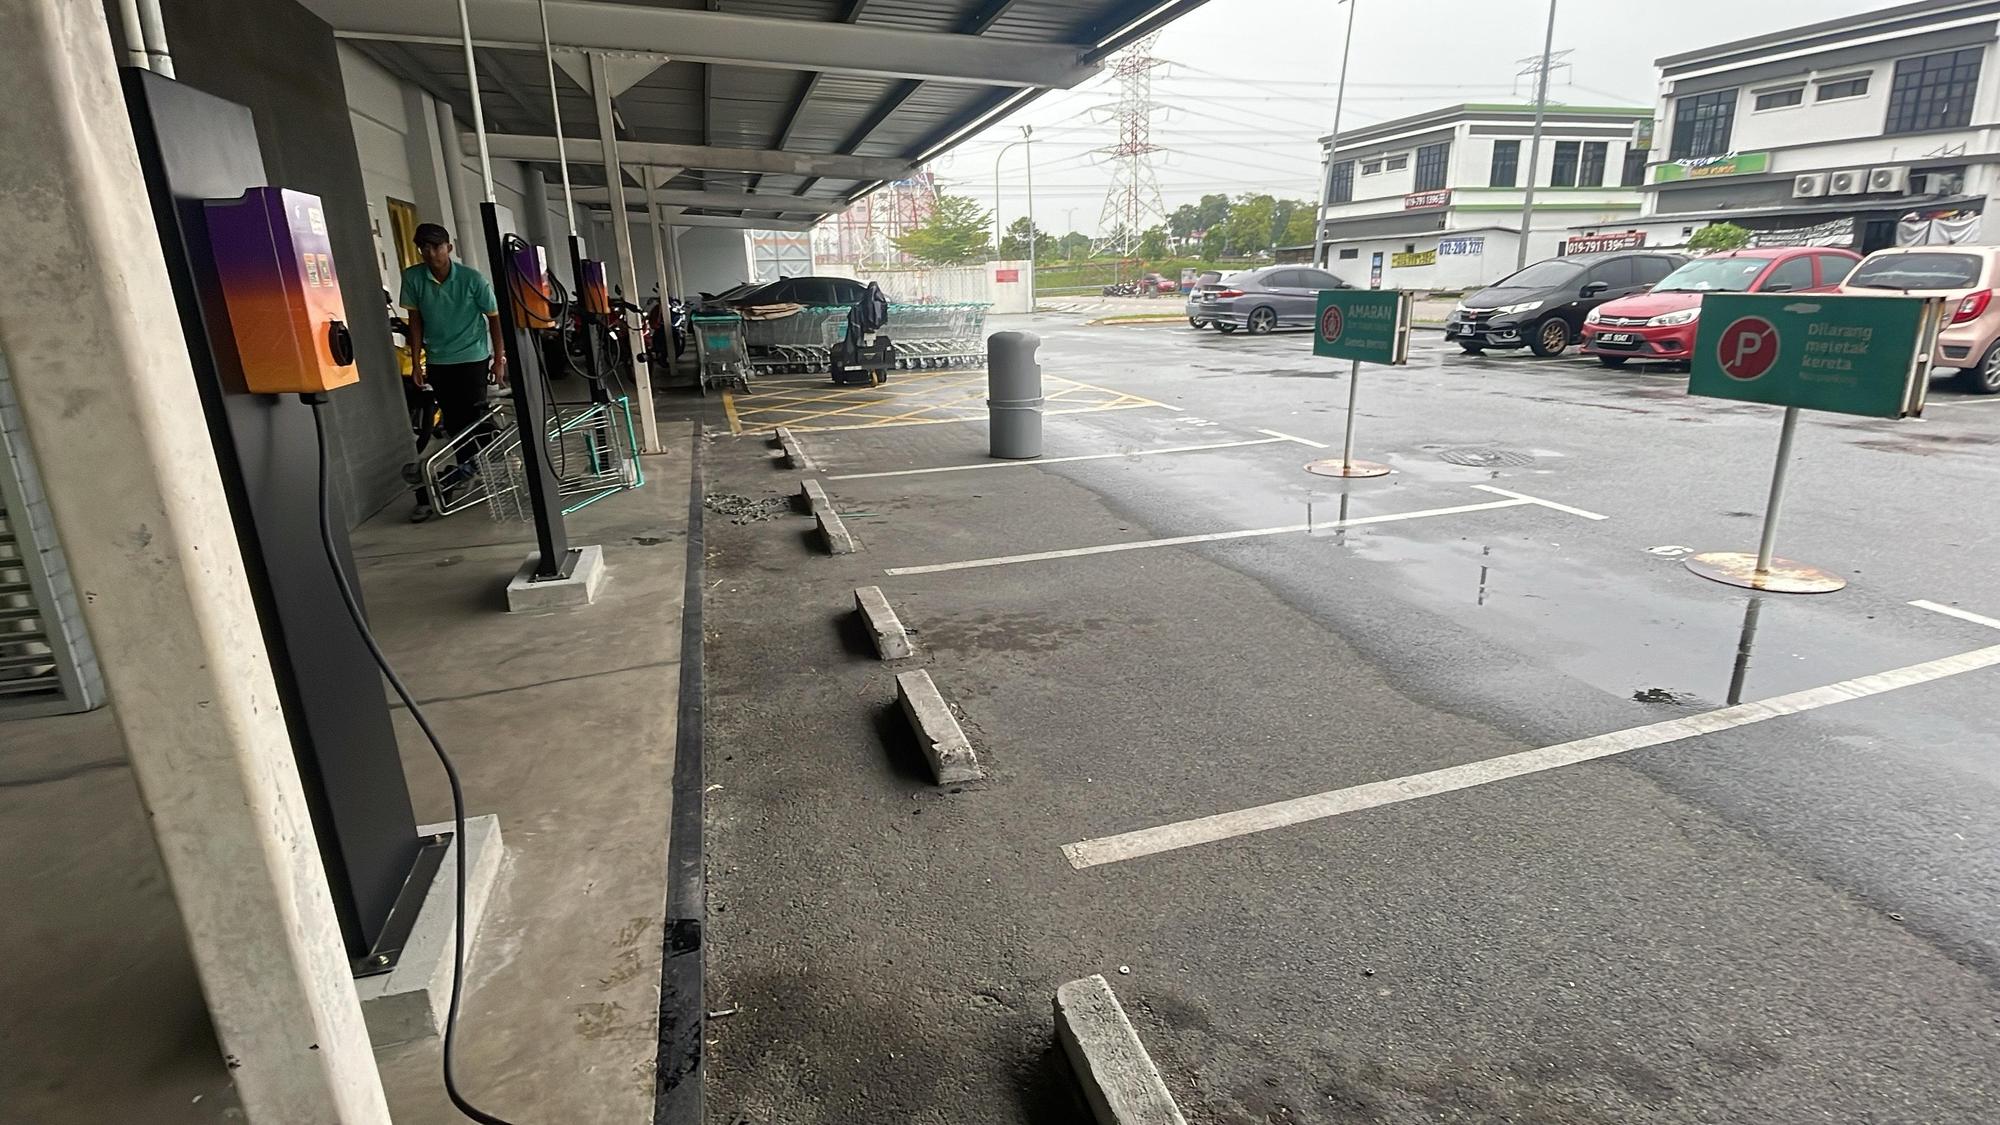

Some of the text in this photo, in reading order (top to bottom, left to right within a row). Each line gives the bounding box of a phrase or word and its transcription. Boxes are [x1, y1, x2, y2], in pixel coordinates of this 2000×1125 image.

[1568, 241, 1600, 254] 019-791
[1602, 239, 1624, 251] 1396
[1347, 304, 1392, 320] AMARAN
[1808, 323, 1873, 341] Dilarang
[1734, 331, 1761, 367] P
[1805, 340, 1869, 354] meletak
[1801, 355, 1852, 370] kereta
